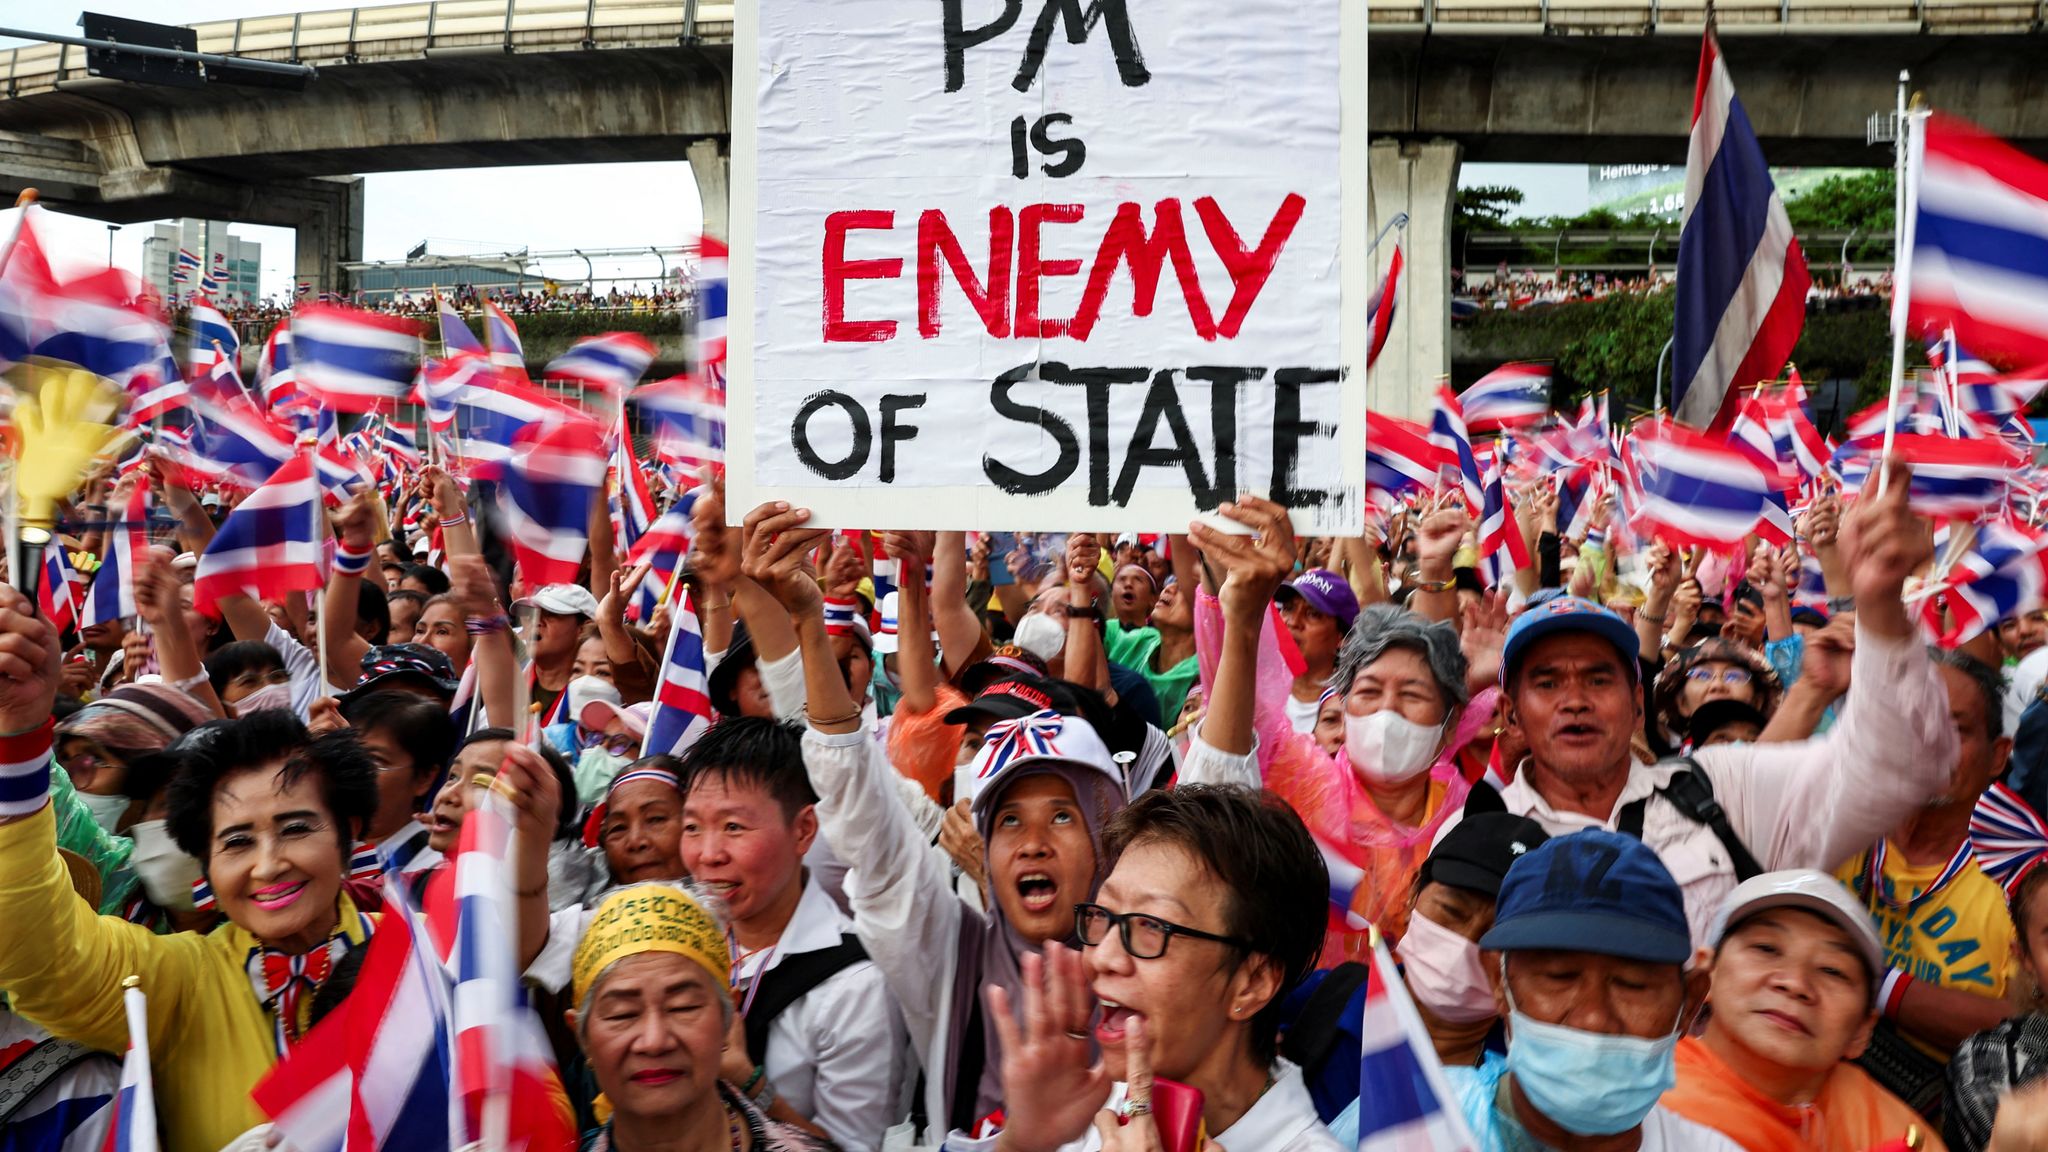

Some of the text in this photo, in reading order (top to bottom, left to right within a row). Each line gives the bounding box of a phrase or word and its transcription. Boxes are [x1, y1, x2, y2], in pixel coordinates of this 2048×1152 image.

[941, 0, 1151, 93] PM
[1011, 112, 1086, 179] IS
[822, 193, 1306, 342] ENEMY
[791, 361, 1350, 512] OF STATE
